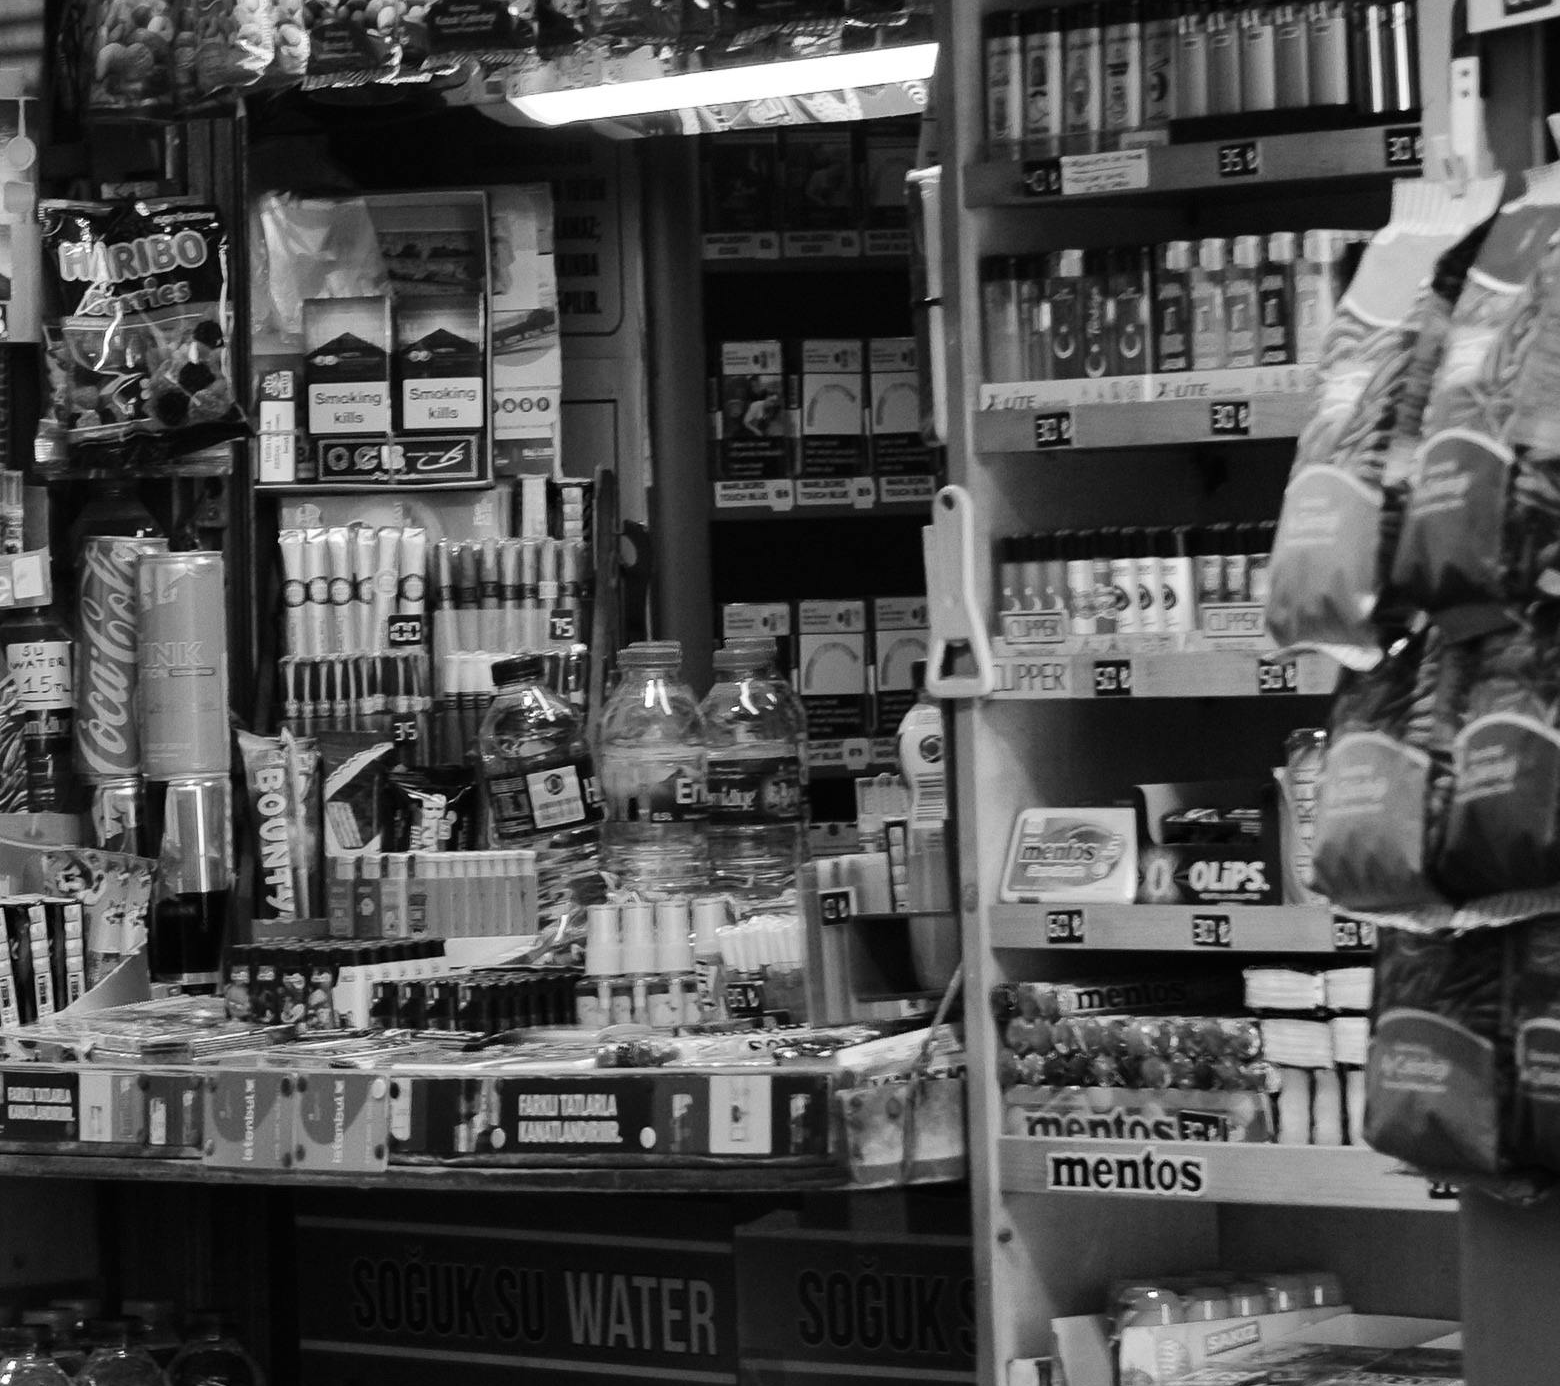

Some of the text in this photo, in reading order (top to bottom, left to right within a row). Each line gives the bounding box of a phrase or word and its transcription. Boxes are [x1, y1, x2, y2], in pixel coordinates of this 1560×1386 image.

[59, 230, 208, 281] HARIBO
[314, 390, 382, 408] Smoking
[409, 385, 477, 403] Smoking
[334, 410, 364, 424] kills
[428, 405, 459, 420] kills
[1051, 1152, 1203, 1192] mentos
[565, 1270, 720, 1356] WATER
